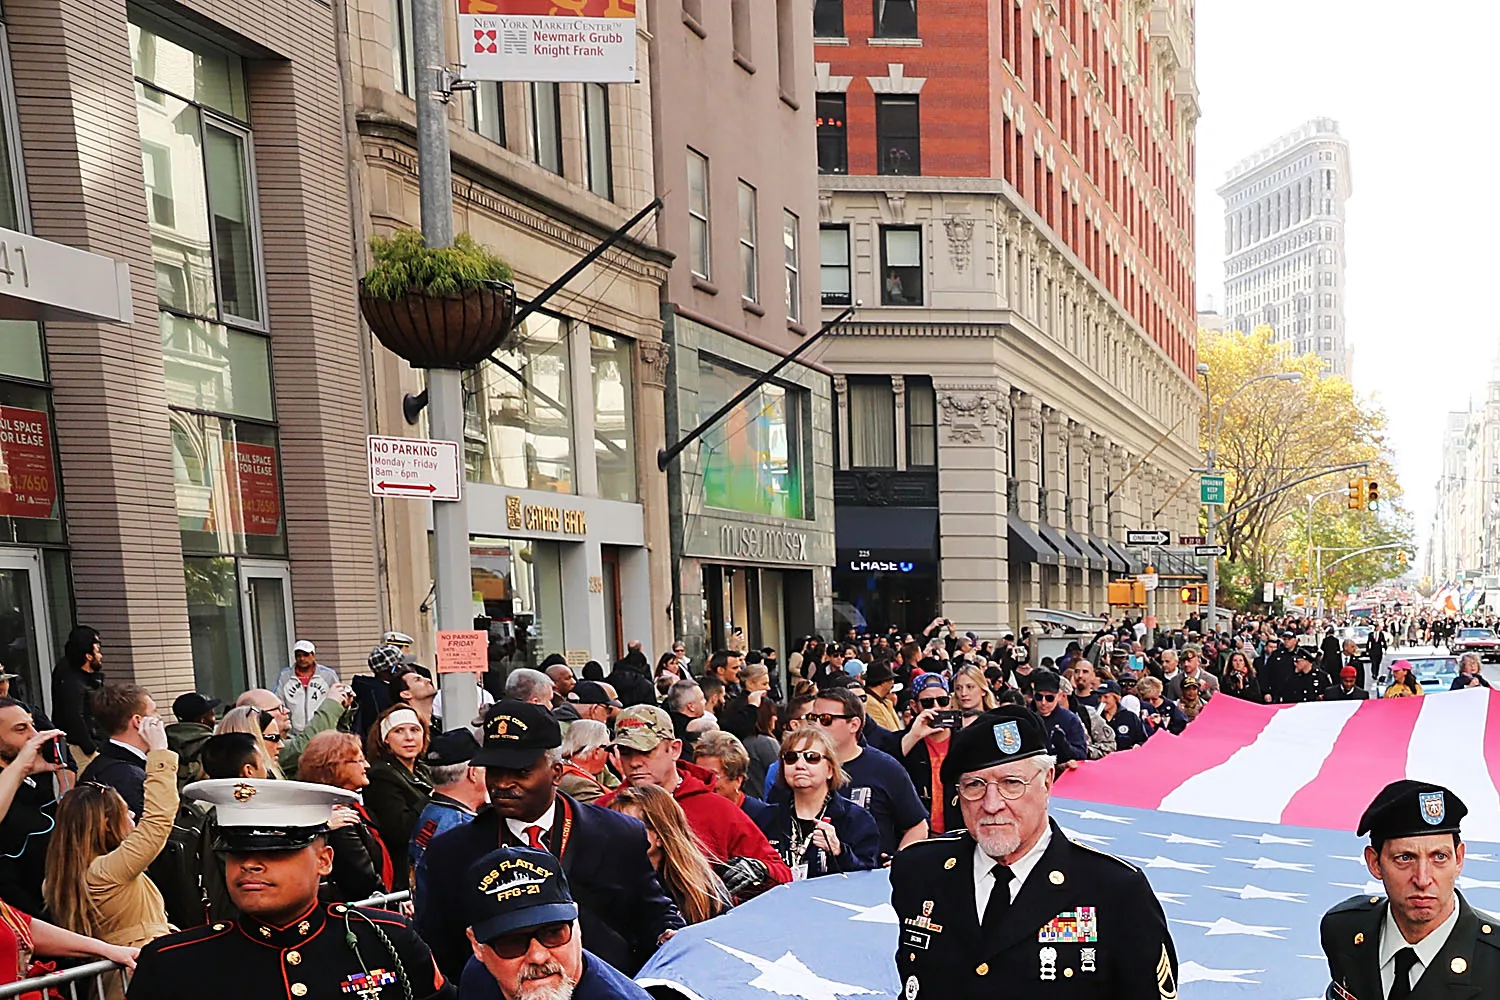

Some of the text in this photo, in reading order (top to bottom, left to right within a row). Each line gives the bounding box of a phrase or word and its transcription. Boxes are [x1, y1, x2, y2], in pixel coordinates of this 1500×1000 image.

[534, 31, 623, 44] Newmark Grubb
[534, 44, 604, 57] Knight Frank
[14, 420, 43, 435] SPACE
[16, 433, 44, 447] LEASE
[374, 442, 438, 457] NO PARKING
[252, 454, 272, 466] SPACE
[374, 457, 405, 467] Monday
[413, 459, 438, 470] Friday
[239, 463, 273, 476] FOR LEASE
[375, 467, 393, 477] 8am
[401, 470, 418, 478] 6pm
[524, 504, 560, 532] CATHAY
[563, 509, 588, 535] BANK
[850, 561, 898, 571] CHASE
[311, 691, 318, 700] 4
[478, 858, 554, 891] USS FLATLEY
[497, 884, 540, 901] FFG-21
